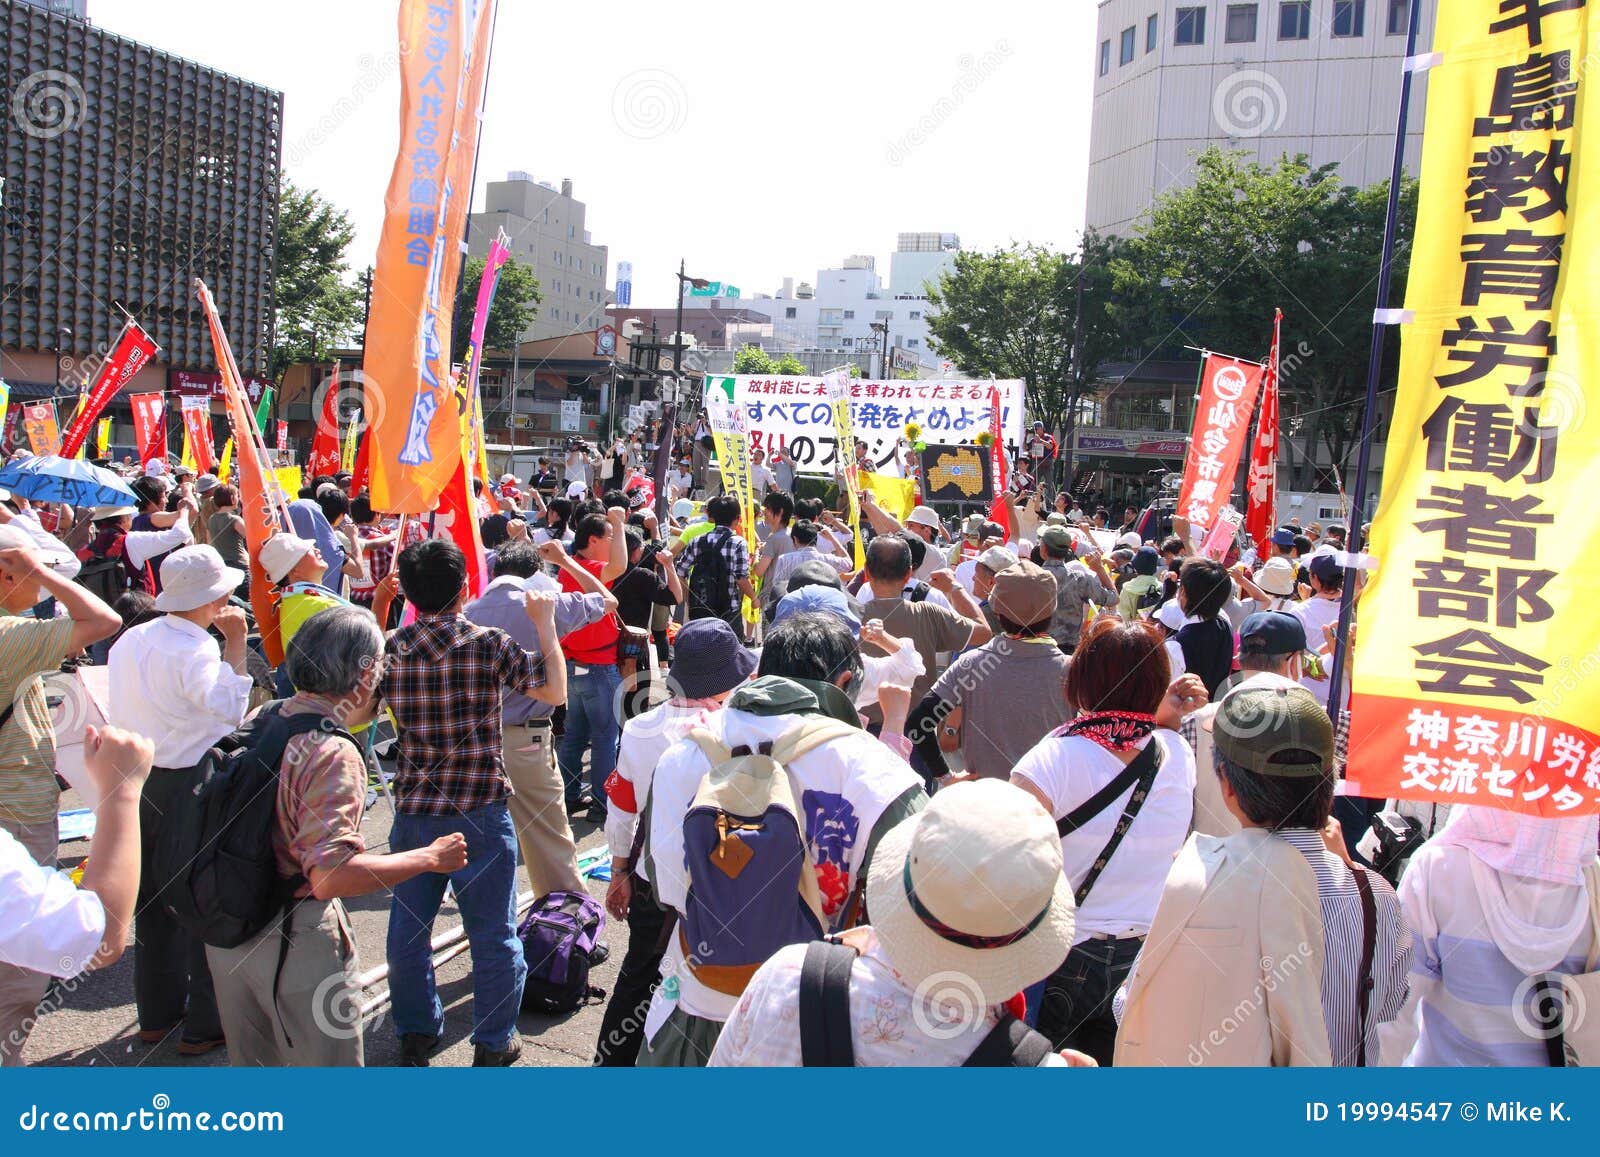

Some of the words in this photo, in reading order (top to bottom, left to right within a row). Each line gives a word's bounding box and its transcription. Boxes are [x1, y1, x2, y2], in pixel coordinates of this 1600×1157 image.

[748, 380, 1010, 399] 放射能に未を奪われてたまるか!
[747, 400, 1010, 430] すべての発をとめよう!
[1400, 752, 1600, 811] 交流センタ
